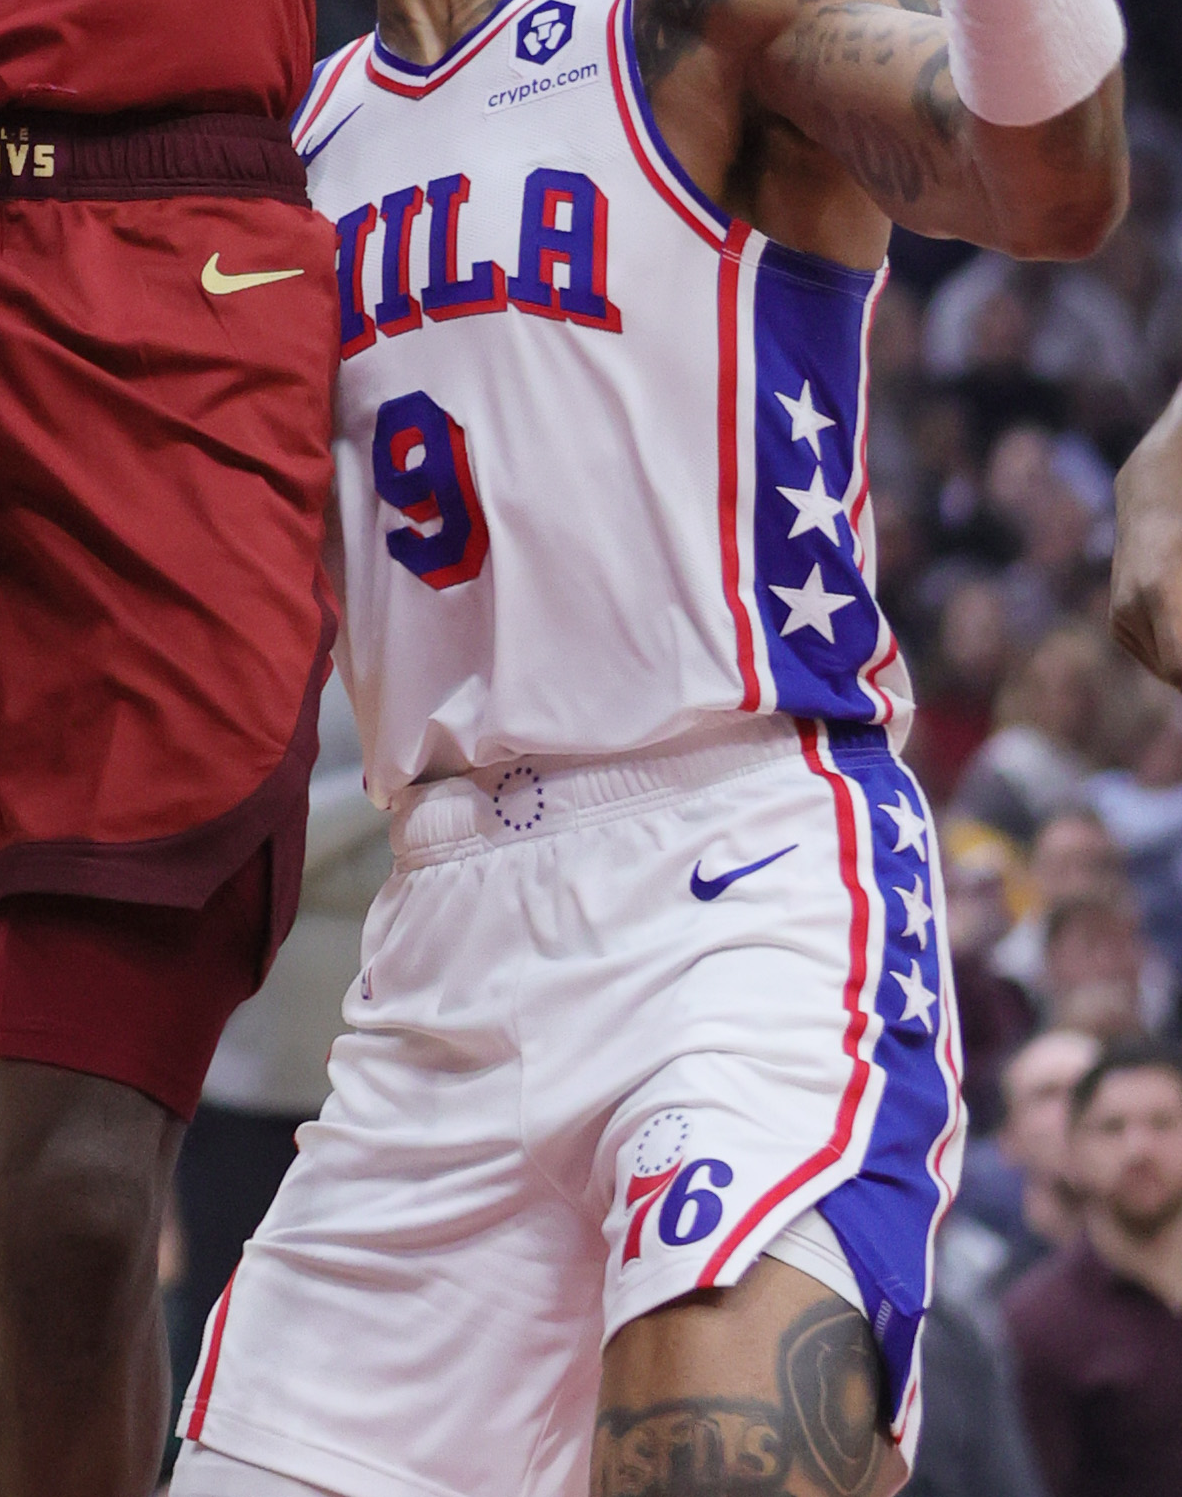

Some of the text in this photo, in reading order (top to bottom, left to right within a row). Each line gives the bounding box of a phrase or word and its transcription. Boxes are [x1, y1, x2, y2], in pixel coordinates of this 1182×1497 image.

[488, 63, 598, 107] crypto.com
[372, 390, 490, 591] 9
[621, 1157, 734, 1269] 76
